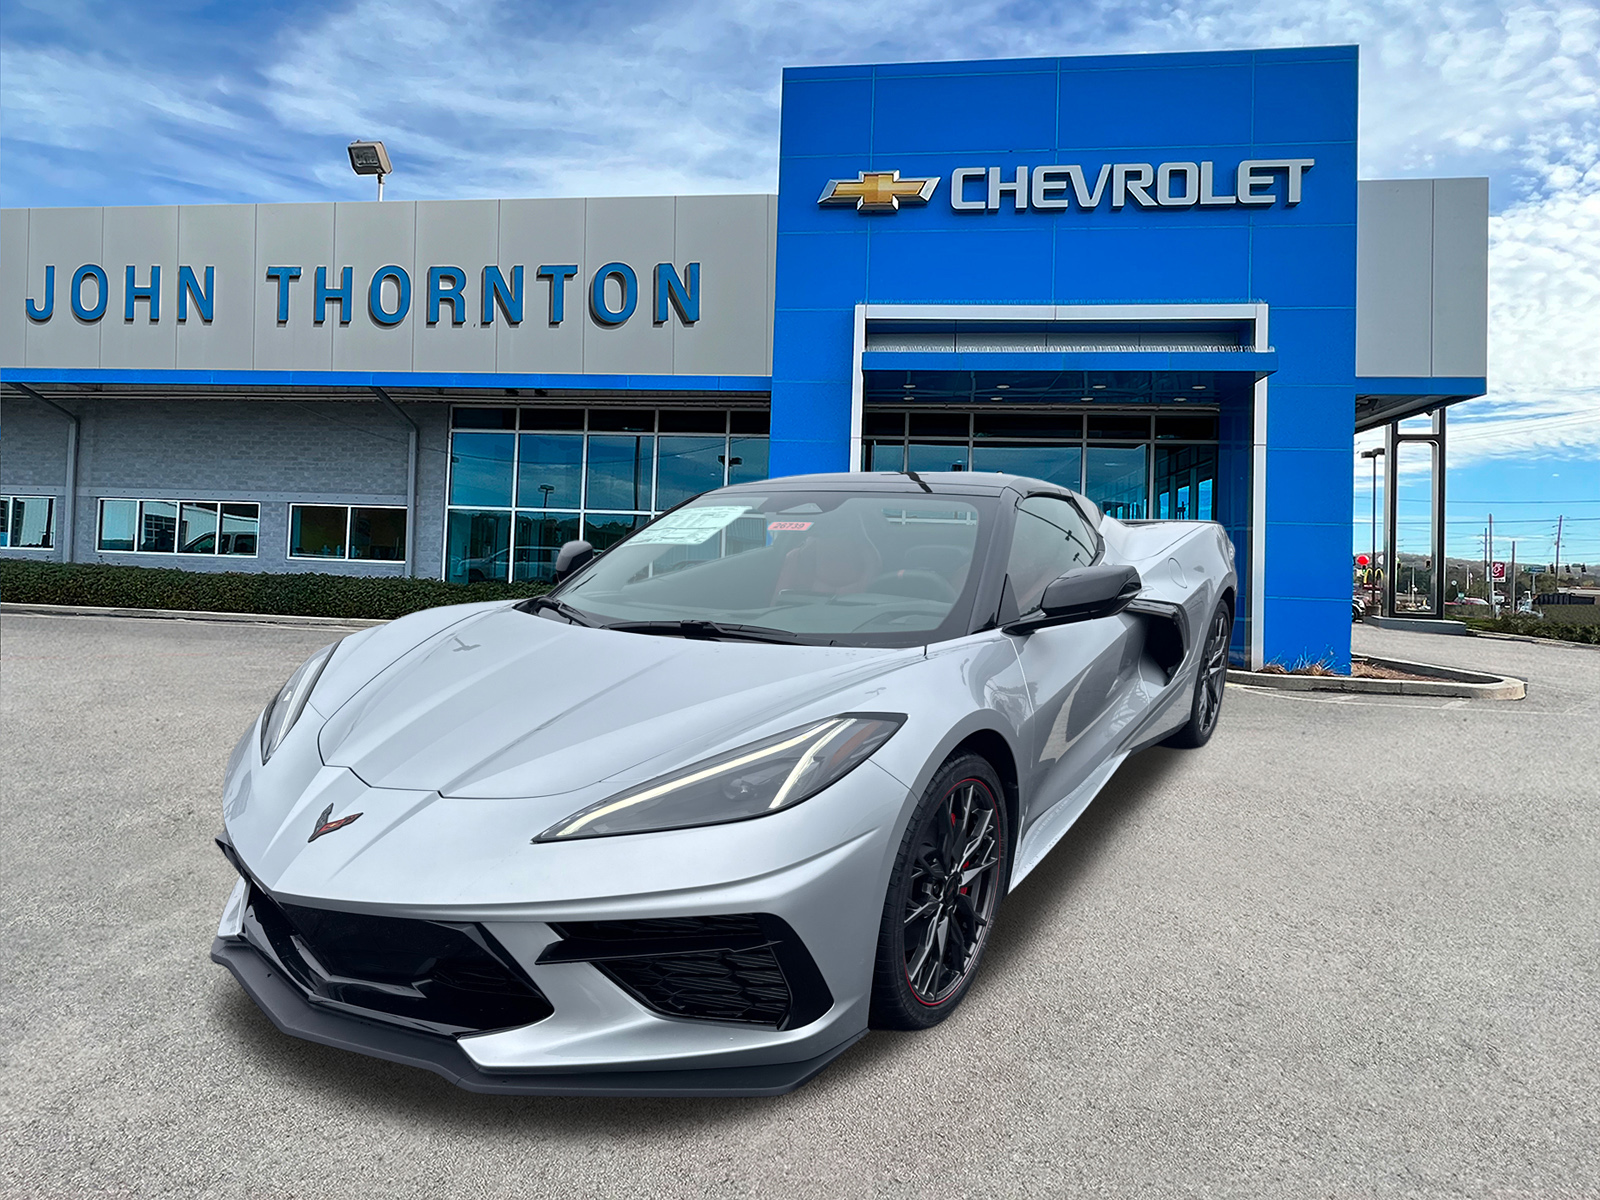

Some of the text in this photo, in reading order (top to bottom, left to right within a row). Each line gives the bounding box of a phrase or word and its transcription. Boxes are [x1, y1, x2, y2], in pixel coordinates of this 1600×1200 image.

[951, 158, 1315, 210] CHEVROLET
[25, 261, 702, 326] JOHN THORNTON
[773, 522, 805, 530] 26739
